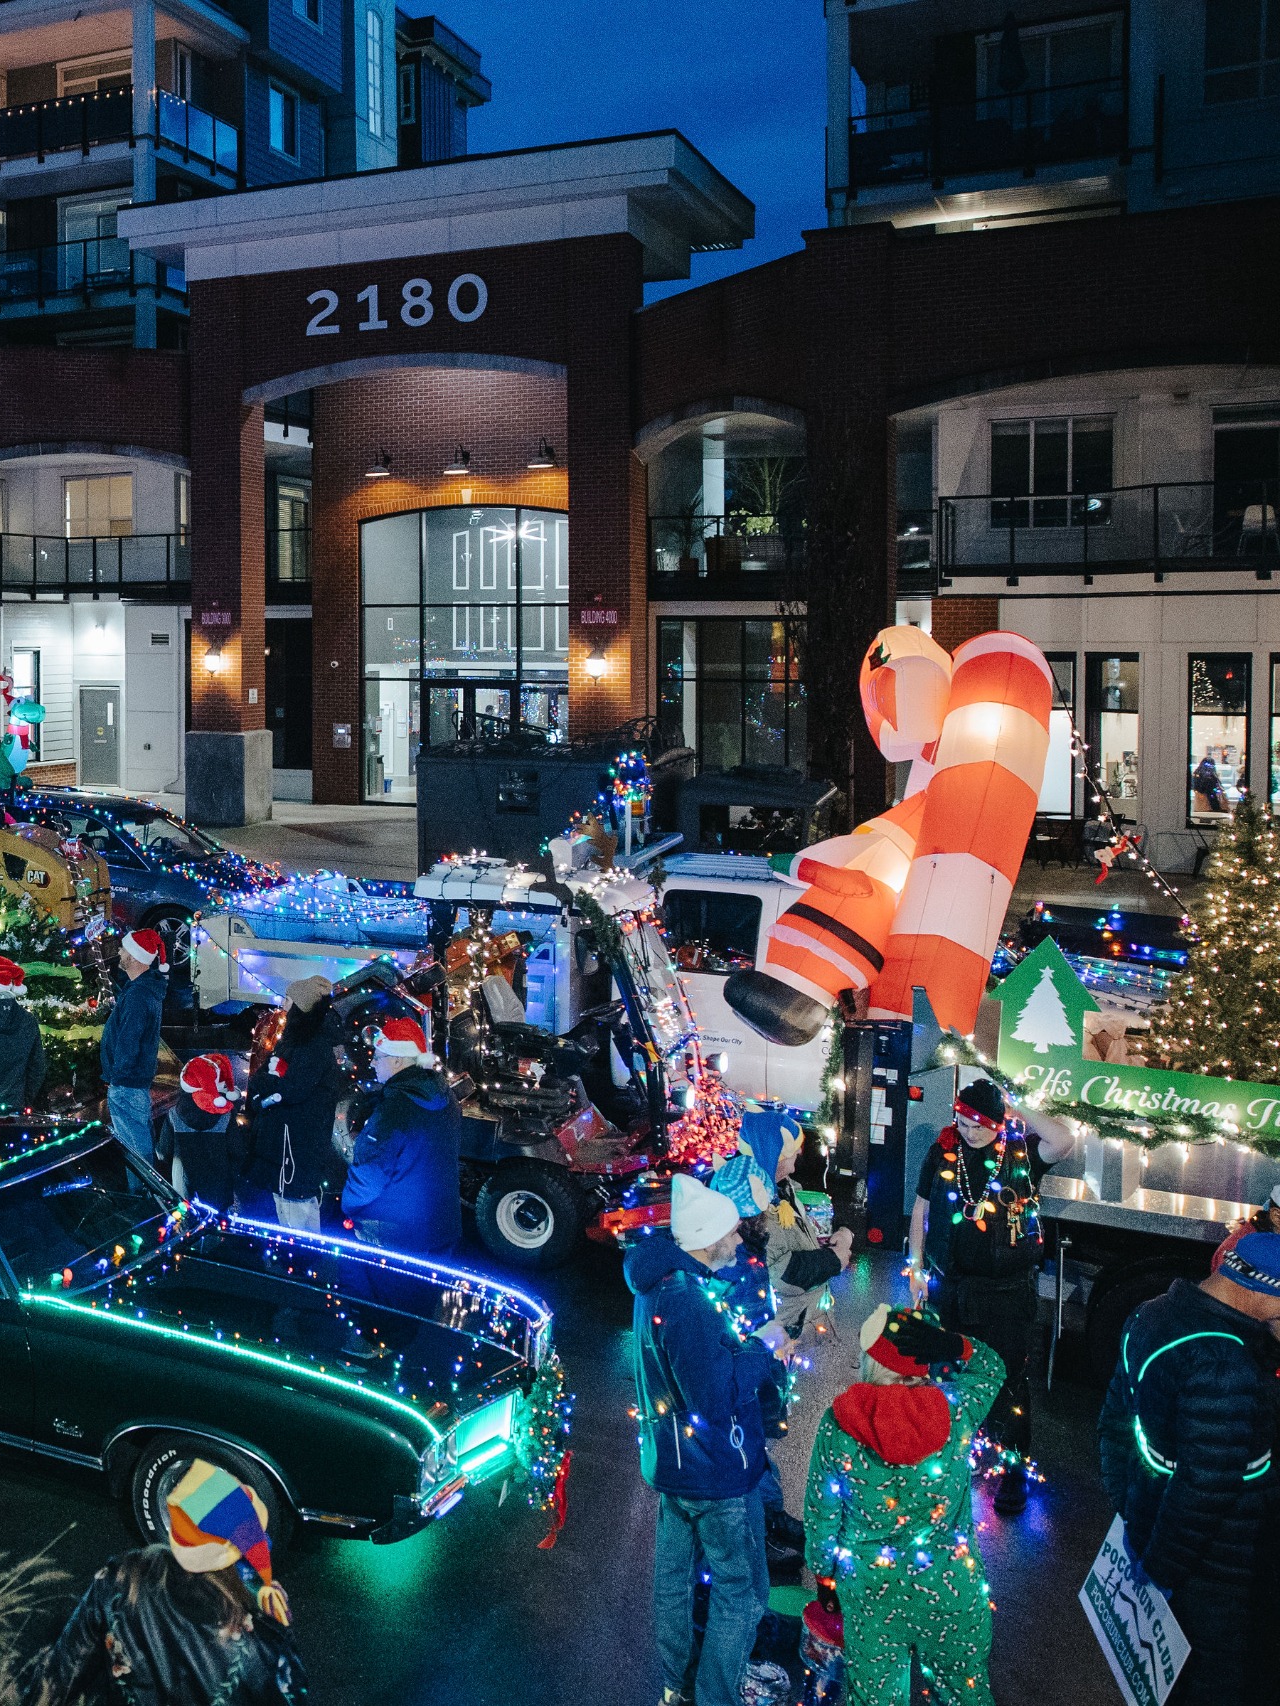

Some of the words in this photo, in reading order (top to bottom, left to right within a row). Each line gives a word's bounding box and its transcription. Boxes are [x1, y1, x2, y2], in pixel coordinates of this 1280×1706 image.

[305, 272, 489, 337] 2180
[581, 610, 605, 624] BUILDING
[27, 870, 46, 885] CAT
[731, 1037, 743, 1046] City
[1081, 1075, 1237, 1119] Christmas
[142, 1449, 177, 1531] BFGoodrich
[1101, 1540, 1133, 1582] POCO
[1131, 1582, 1156, 1621] RUN
[1151, 1618, 1175, 1686] CLUB
